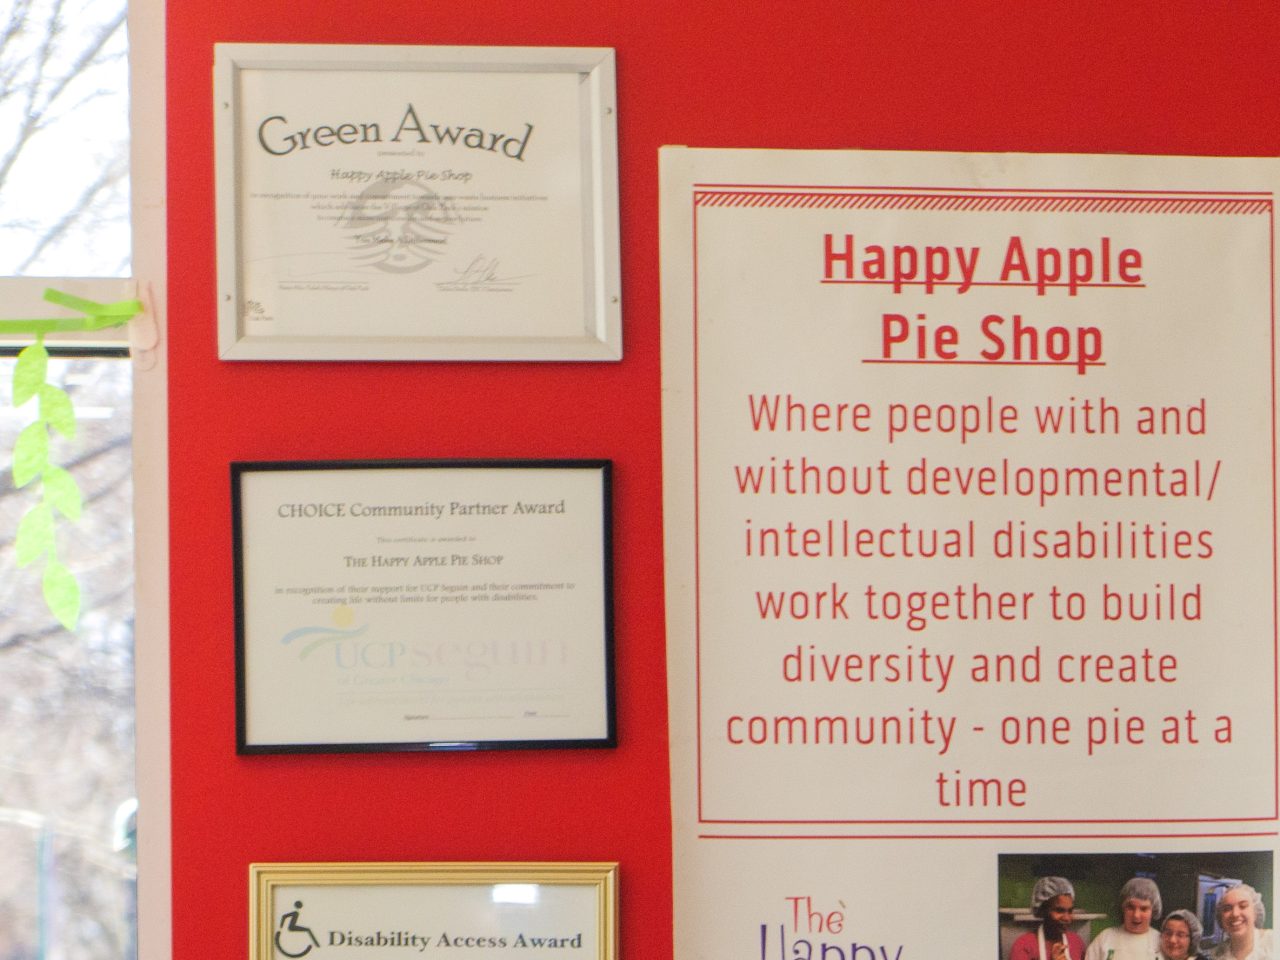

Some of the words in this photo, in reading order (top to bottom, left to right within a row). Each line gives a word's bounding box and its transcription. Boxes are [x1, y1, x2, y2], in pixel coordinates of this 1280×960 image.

[257, 114, 382, 156] Green
[390, 102, 536, 162] Award
[331, 168, 374, 183] Happy
[376, 169, 414, 183] Apple
[416, 169, 439, 181] Pie
[440, 169, 474, 184] Shop
[823, 233, 980, 294] Happy
[1000, 236, 1144, 296] Apple
[882, 313, 960, 360] Pie
[980, 315, 1104, 375] Shop
[748, 394, 872, 433] Where
[888, 396, 1019, 444] people
[1034, 397, 1121, 436] with
[1136, 398, 1208, 436] and
[734, 458, 892, 496] without
[906, 458, 1222, 508] developmental/
[277, 503, 346, 518] CHOICE
[350, 500, 445, 520] Community
[449, 501, 509, 516] Partner
[513, 499, 566, 515] Award
[744, 519, 976, 559] intellectual
[993, 520, 1215, 560] disabilities
[756, 582, 849, 621] work
[865, 583, 1035, 631] together
[1050, 588, 1087, 621] to
[1102, 583, 1203, 621] build
[782, 645, 955, 694] diversity
[970, 645, 1041, 683] and
[1057, 648, 1179, 683] create
[726, 707, 957, 755] community
[1000, 714, 1072, 745] one
[1087, 708, 1146, 756] pie
[1161, 708, 1199, 745] at
[1214, 714, 1234, 745] a
[936, 770, 1028, 808] time
[785, 896, 845, 934] The
[328, 931, 432, 953] Disability
[437, 932, 507, 948] Access
[513, 932, 583, 949] Award
